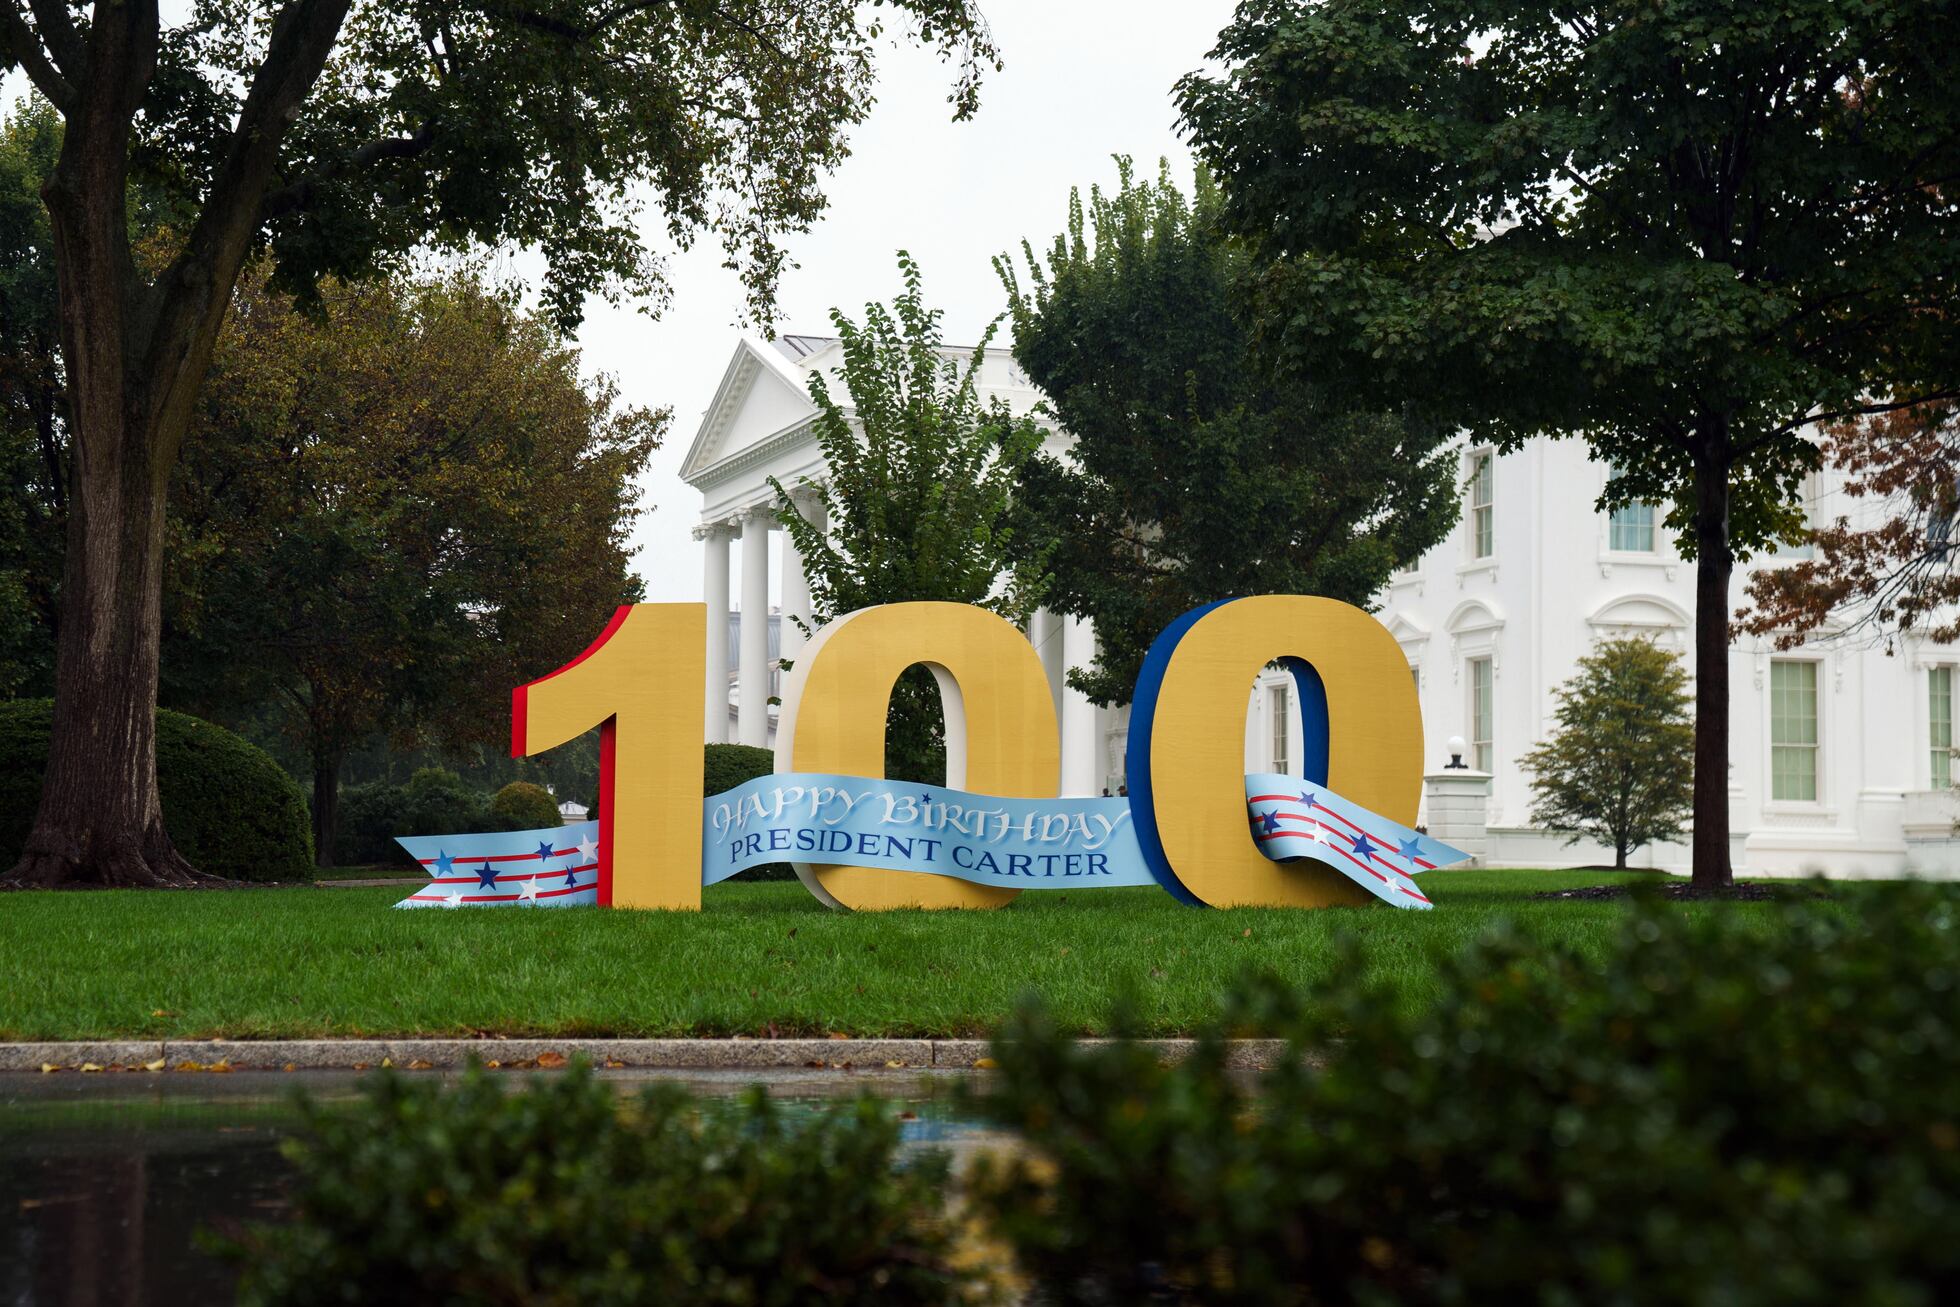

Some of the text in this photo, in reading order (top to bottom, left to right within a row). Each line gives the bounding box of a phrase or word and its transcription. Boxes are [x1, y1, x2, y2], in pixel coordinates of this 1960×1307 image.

[512, 594, 1424, 912] 100
[712, 785, 874, 844] HAPPY
[730, 828, 1113, 877] PRESIDENT CARTER
